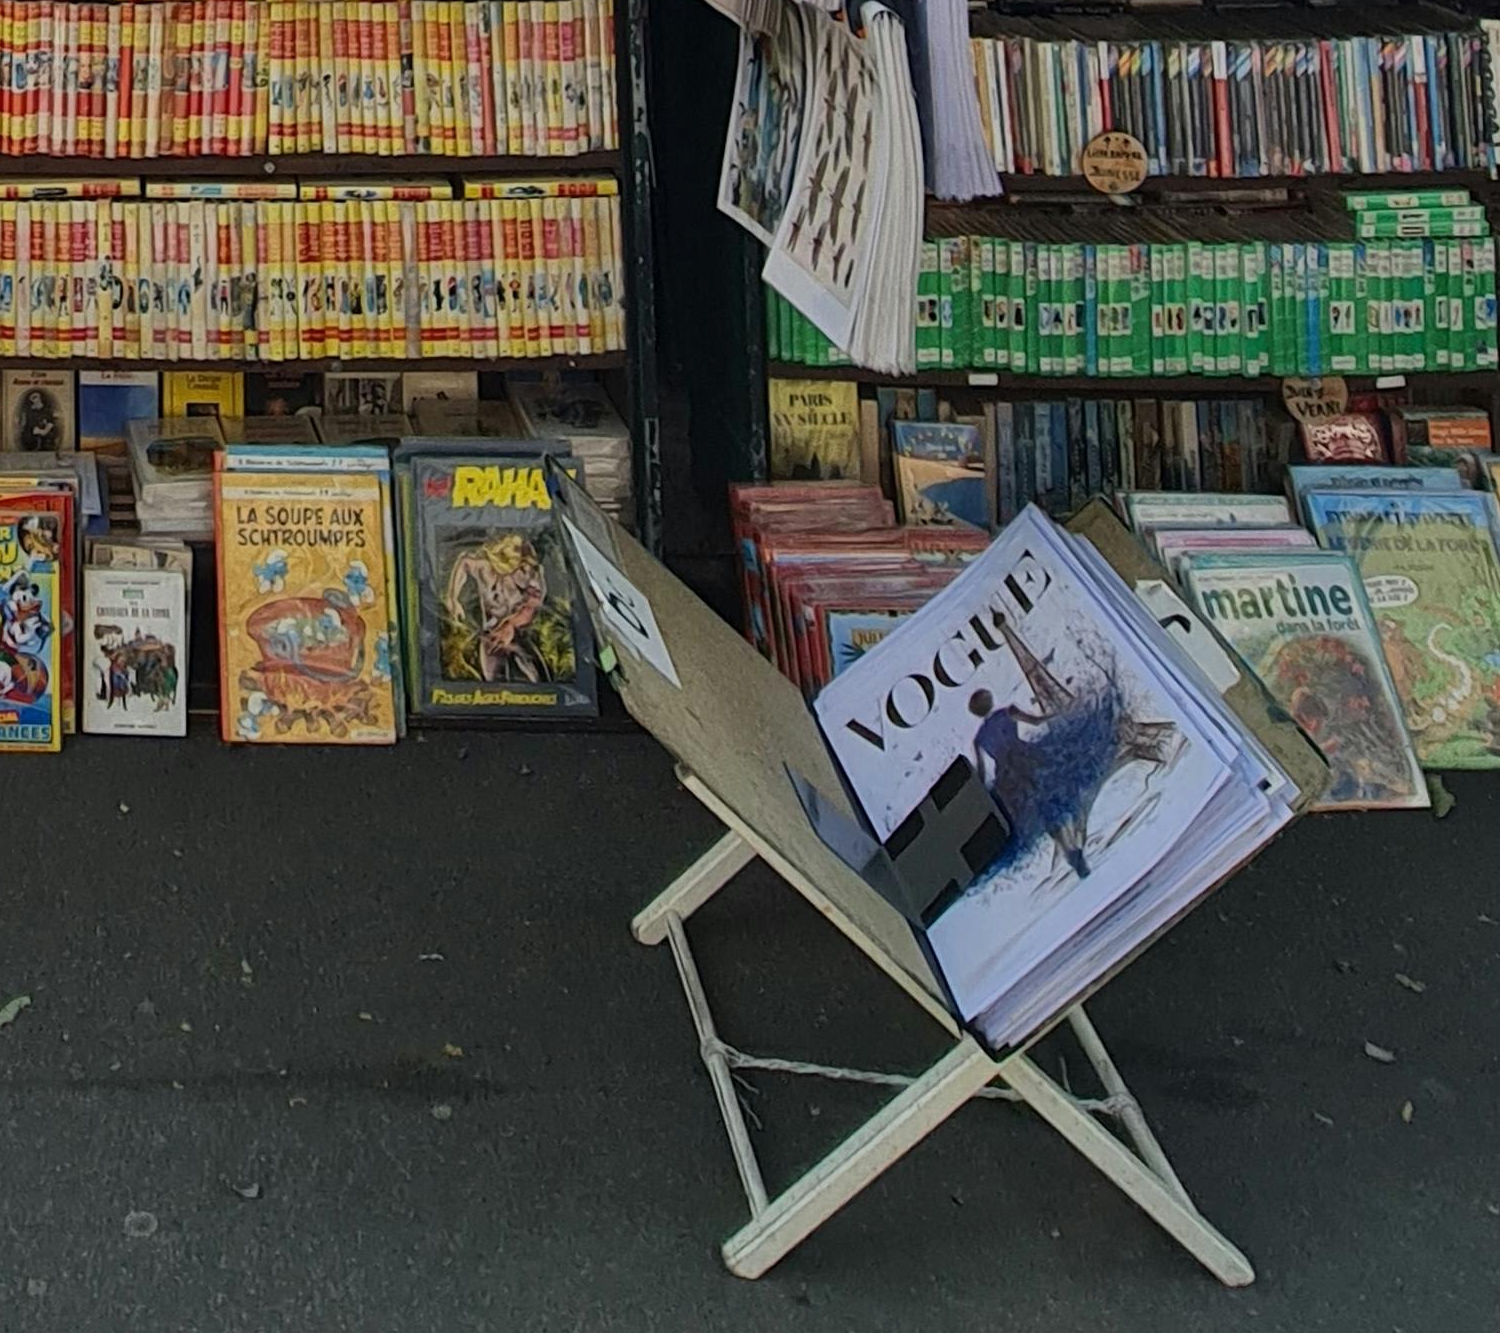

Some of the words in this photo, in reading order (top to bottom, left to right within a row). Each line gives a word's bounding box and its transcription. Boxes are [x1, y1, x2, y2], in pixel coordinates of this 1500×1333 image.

[788, 393, 833, 408] PARIS
[452, 464, 577, 510] RAHA
[236, 506, 258, 525] LA
[265, 506, 324, 526] SOUPE
[329, 507, 365, 527] AUX
[237, 527, 367, 548] SCHTROUMPFS
[1201, 572, 1354, 621] martine
[1275, 619, 1308, 634] dans
[1310, 618, 1326, 632] la
[845, 548, 1053, 752] VOGUE
